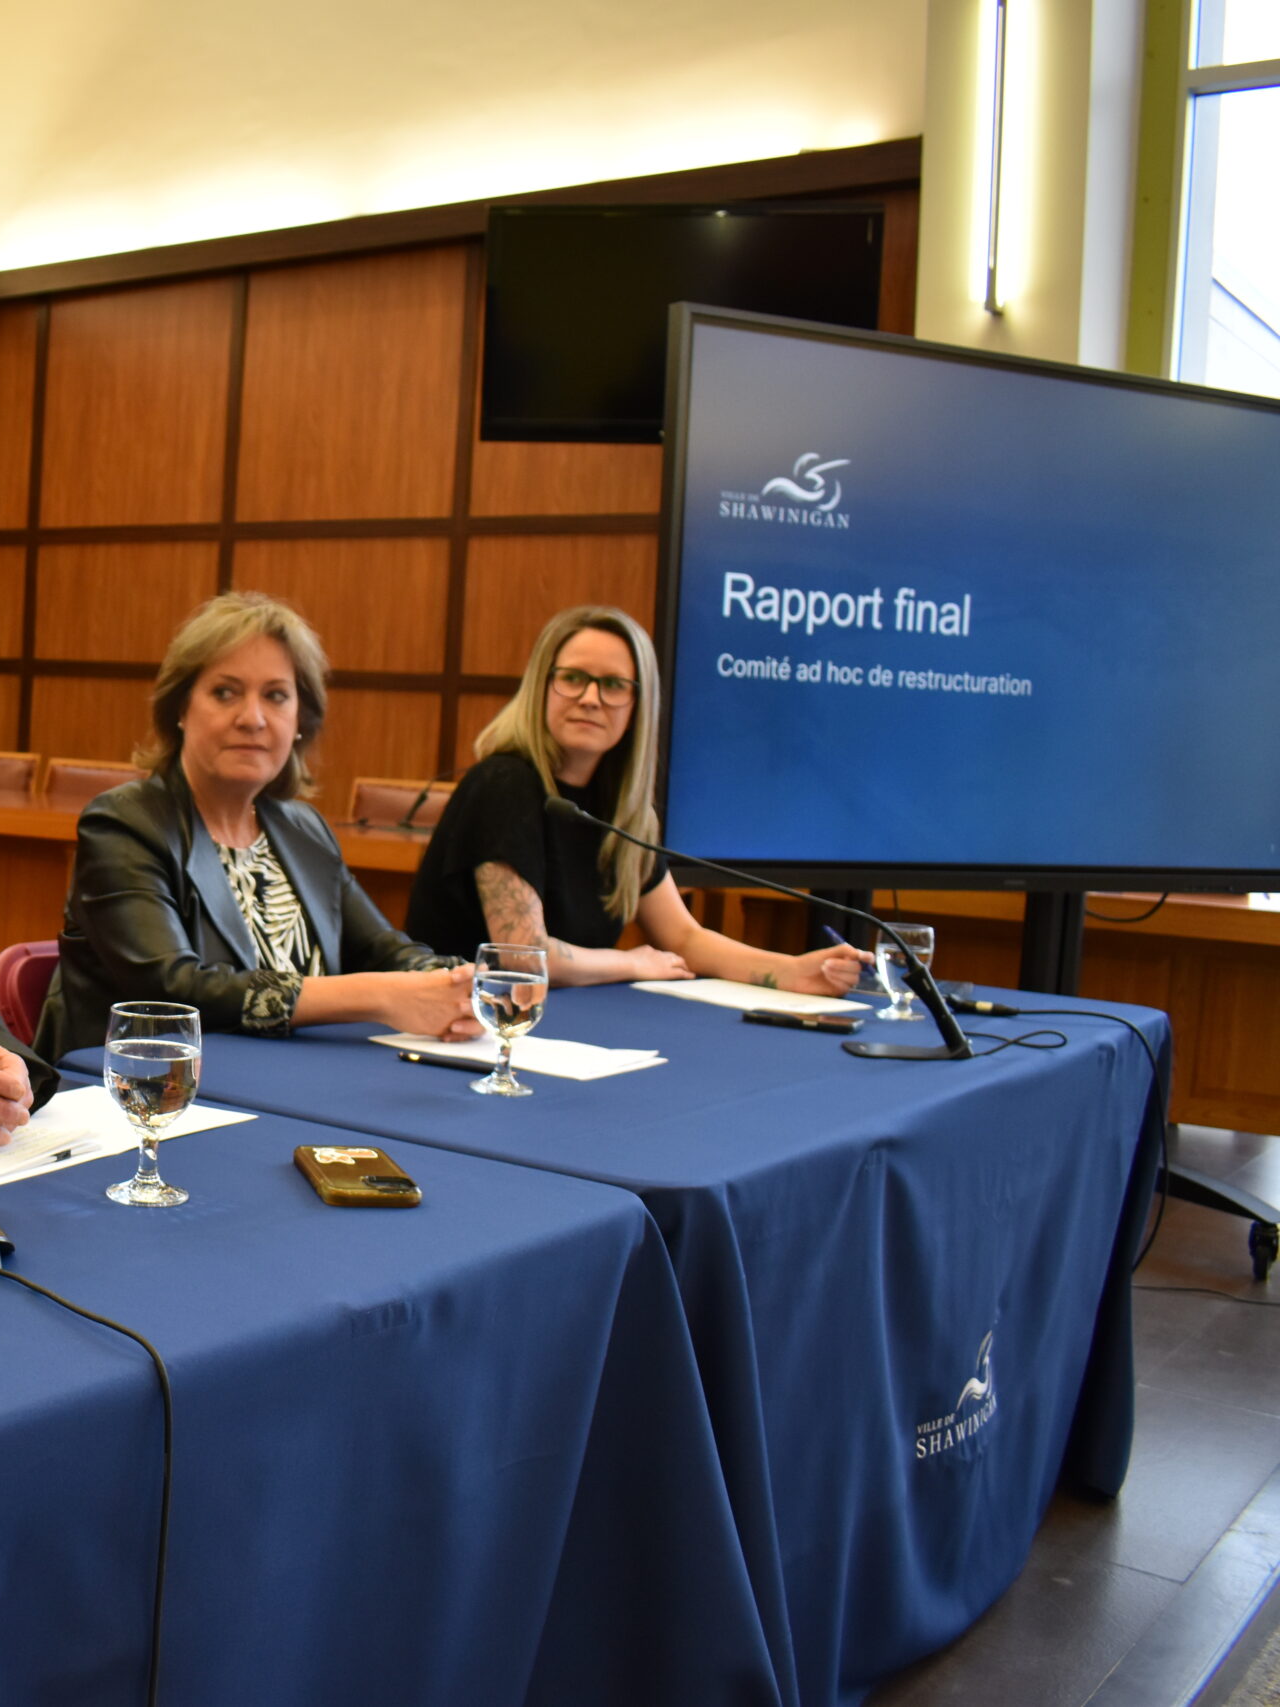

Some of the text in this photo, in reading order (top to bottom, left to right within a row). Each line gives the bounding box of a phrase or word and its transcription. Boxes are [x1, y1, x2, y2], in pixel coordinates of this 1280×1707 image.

[719, 501, 850, 529] SHAWINIGAN
[723, 571, 971, 637] Rapport final
[717, 653, 1032, 696] Comité ad hoc de restructuration
